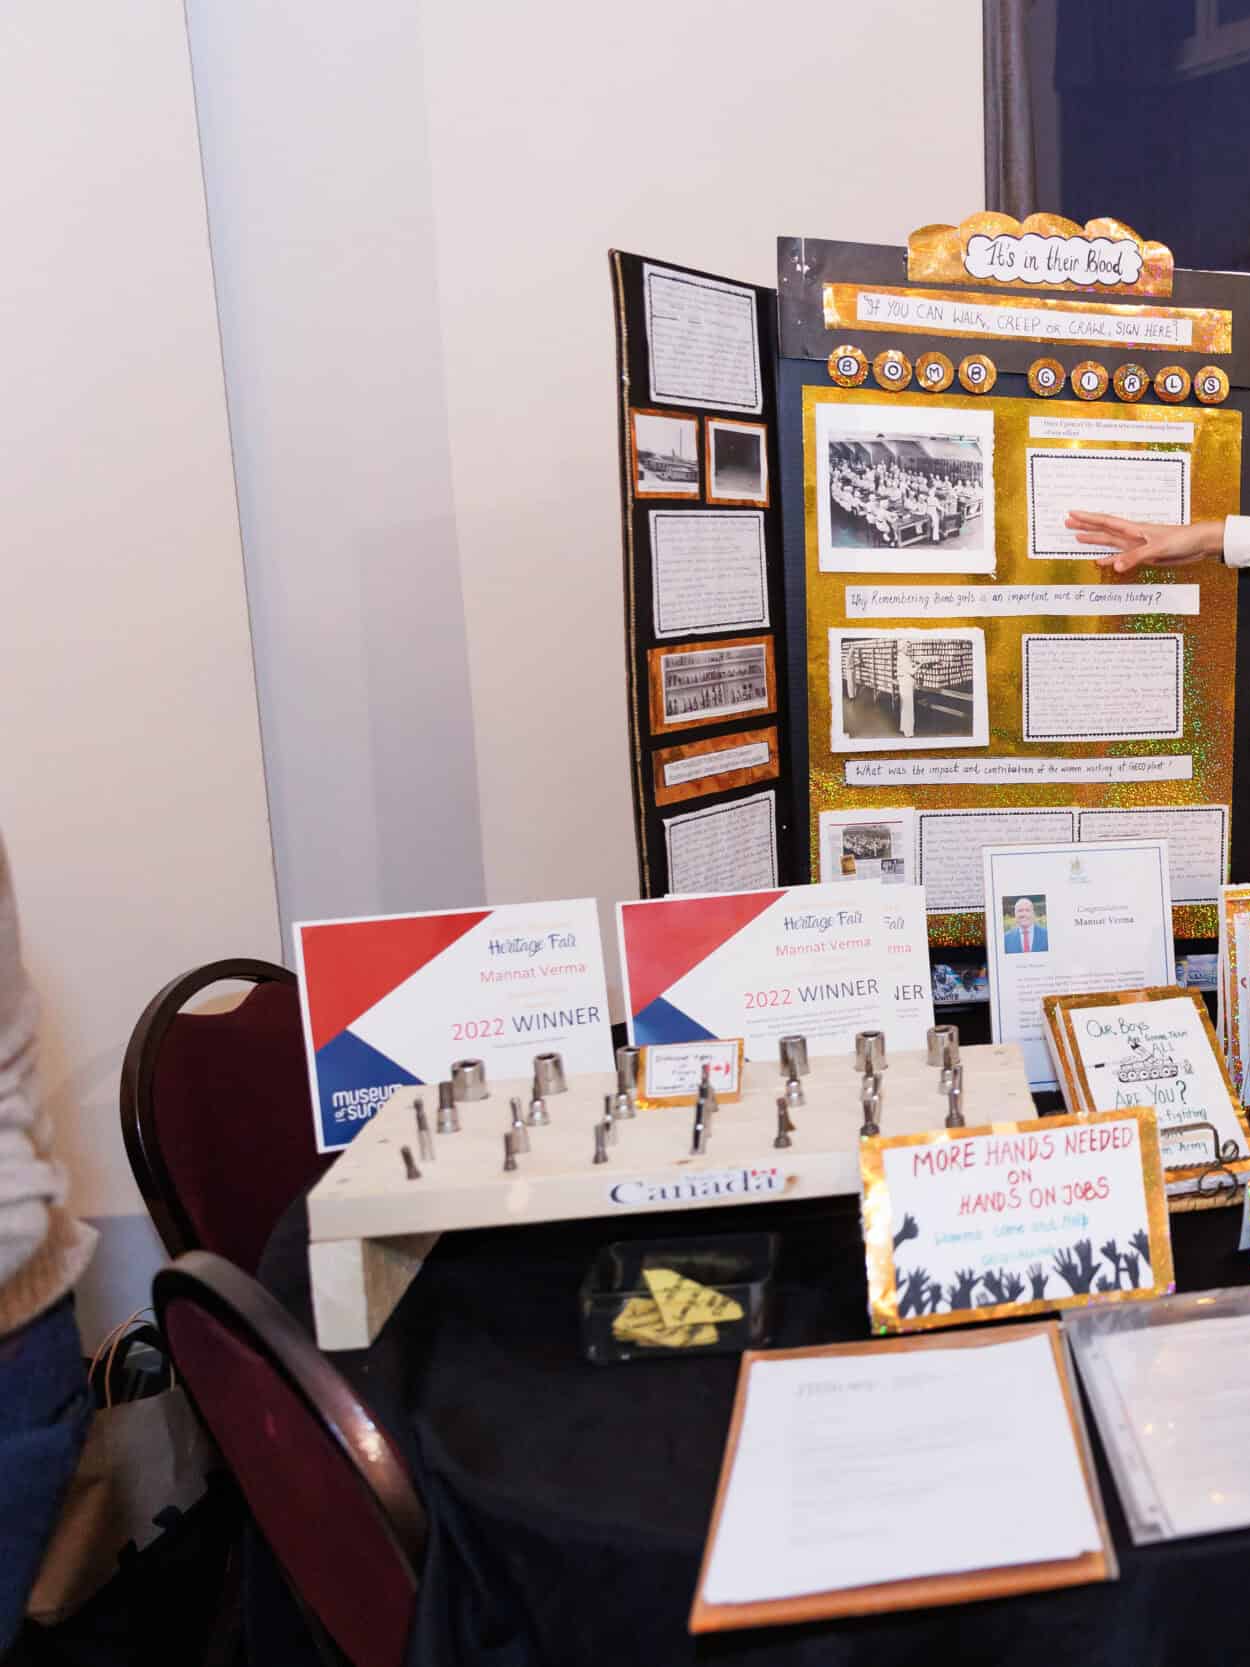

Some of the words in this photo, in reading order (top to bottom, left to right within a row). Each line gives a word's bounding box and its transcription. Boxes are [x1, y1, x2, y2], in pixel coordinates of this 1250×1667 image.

[985, 240, 1015, 268] It's
[1024, 250, 1039, 271] in
[1047, 244, 1080, 271] their
[1085, 249, 1123, 275] Blood
[886, 300, 909, 319] YOU
[916, 303, 944, 321] CAN
[997, 314, 1041, 332] CREEP
[1115, 320, 1140, 337] SIGN
[991, 592, 1003, 602] an
[1007, 591, 1049, 605] important
[856, 764, 882, 777] What
[888, 767, 906, 776] was
[912, 764, 925, 776] the
[929, 762, 958, 776] impact
[963, 763, 978, 775] and
[784, 914, 833, 933] Heritage
[838, 910, 864, 926] Fair
[1073, 917, 1105, 927] Mannat
[1107, 916, 1135, 926] Verma
[487, 938, 544, 958] Heritage
[547, 932, 577, 950] Fair
[775, 941, 827, 957] Mannat
[830, 937, 872, 951] Verma
[480, 967, 537, 983] Mannat
[538, 962, 587, 977] Verma
[744, 988, 793, 1009] 2022
[797, 978, 880, 1003] WINNER
[452, 1017, 505, 1041] 2022
[511, 1005, 601, 1033] WINNER
[912, 1141, 976, 1177] MORE
[984, 1134, 1055, 1167] HANDS
[1064, 1126, 1133, 1156] NEEDED
[610, 1170, 776, 1204] Canada
[1007, 1169, 1033, 1185] ON
[959, 1187, 1022, 1215] HANDS
[1029, 1186, 1056, 1209] ON
[1062, 1176, 1110, 1206] JOBS
